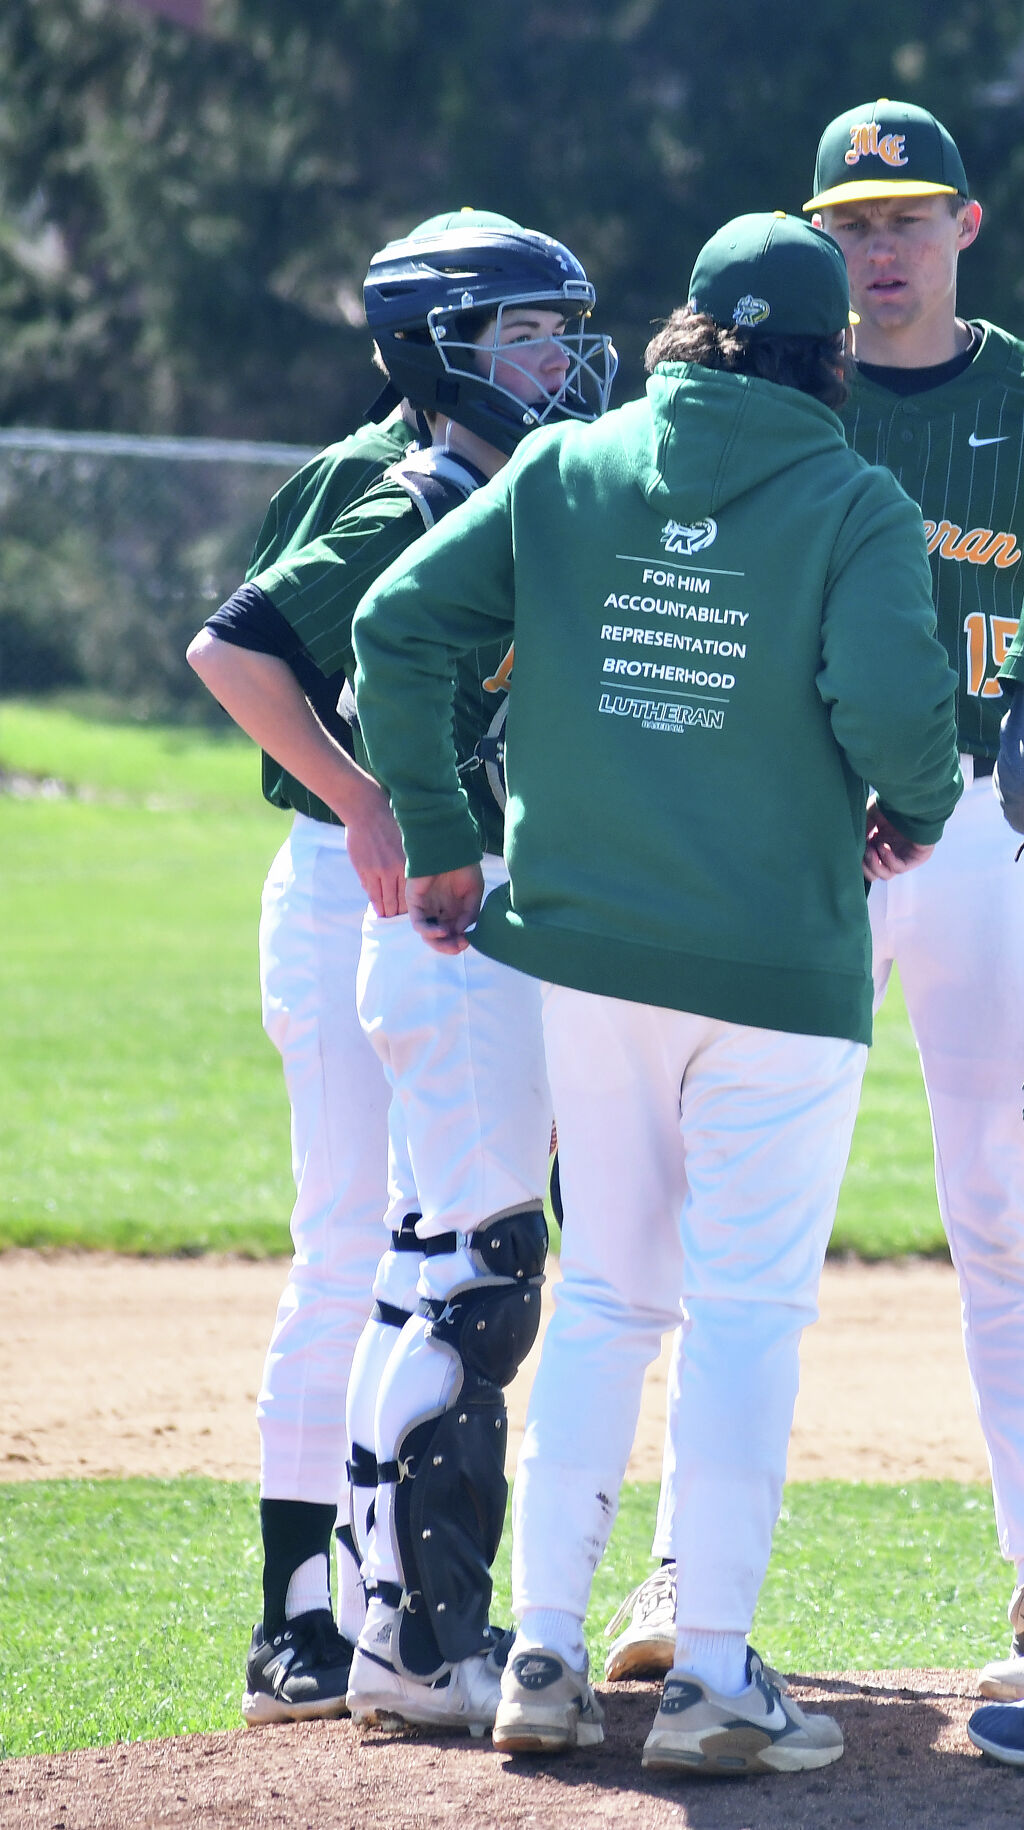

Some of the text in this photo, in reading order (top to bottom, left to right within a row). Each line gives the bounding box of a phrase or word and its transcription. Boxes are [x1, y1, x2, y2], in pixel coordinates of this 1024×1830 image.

[642, 568, 711, 594] FOR HIM
[603, 593, 750, 627] ACCOUNTABILITY
[601, 624, 747, 659] REPRESENTATION
[964, 612, 1020, 699] 15
[602, 657, 736, 690] BROTHERHOOD
[598, 693, 725, 730] LUTHERAN
